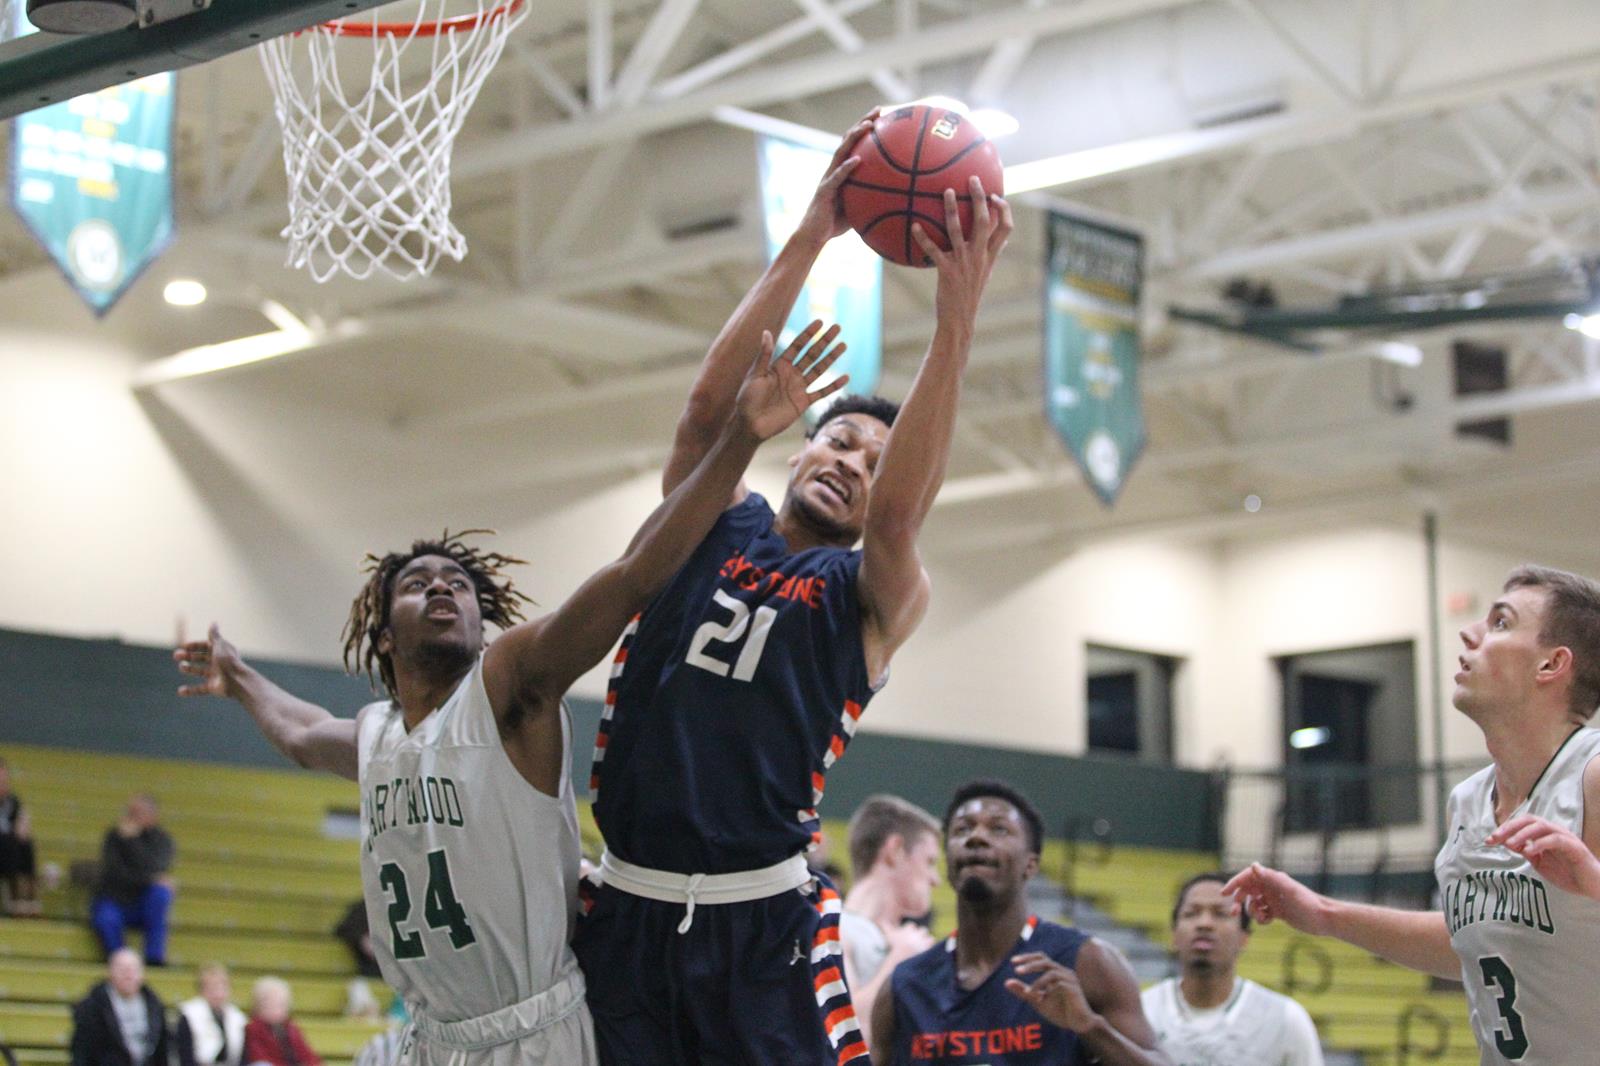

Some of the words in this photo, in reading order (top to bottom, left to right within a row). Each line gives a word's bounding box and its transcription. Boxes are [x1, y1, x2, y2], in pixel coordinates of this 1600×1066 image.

[720, 553, 827, 609] EYSTONE
[685, 588, 778, 682] 21
[380, 850, 476, 959] 24
[1479, 956, 1529, 1060] 3
